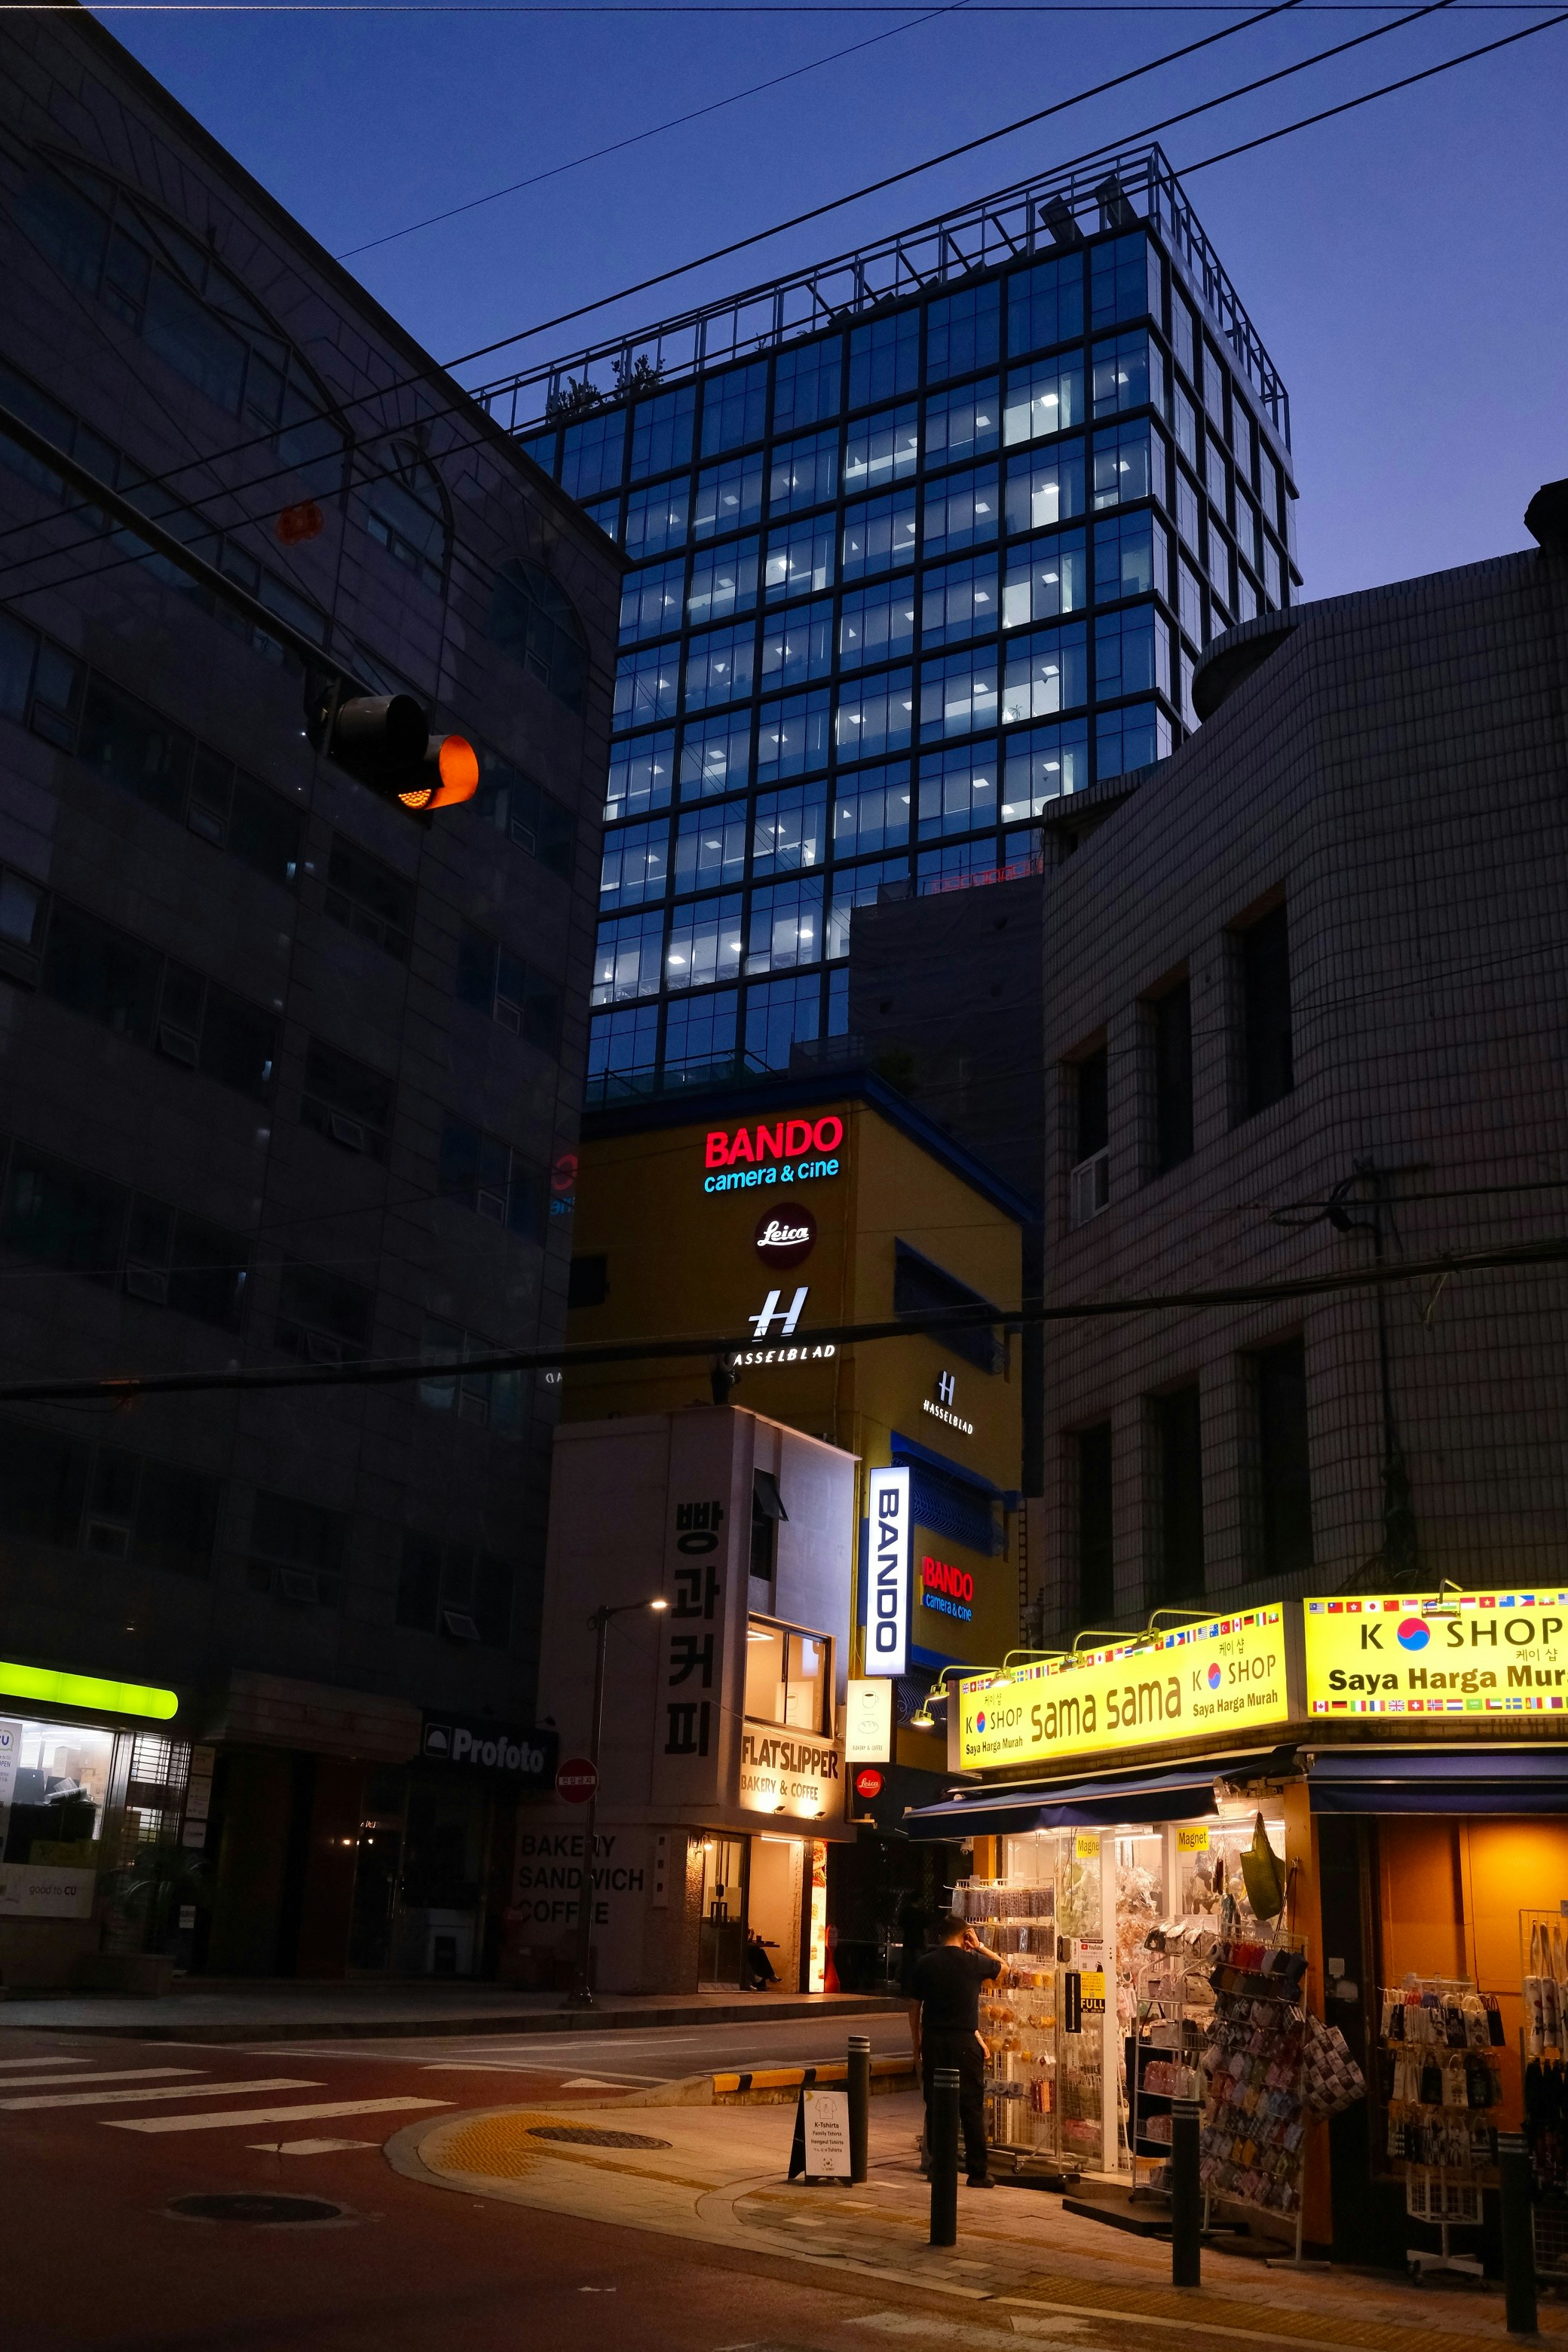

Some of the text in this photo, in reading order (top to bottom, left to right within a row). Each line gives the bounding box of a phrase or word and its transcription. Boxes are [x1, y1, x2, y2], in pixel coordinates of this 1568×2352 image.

[705, 1116, 844, 1168] BANDO
[704, 1159, 839, 1193] camera & cine
[757, 1220, 810, 1247] Leica
[733, 1345, 835, 1367] ASSELBLAD
[923, 1399, 973, 1435] HASSELBLAD
[876, 1488, 899, 1652] BANDO
[924, 1556, 974, 1602] BANDO
[926, 1593, 972, 1622] camera & cine
[665, 1501, 724, 1756] 빵과커피
[1361, 1617, 1563, 1649] K SHOP
[1220, 1637, 1245, 1657] 케이 샵
[1515, 1648, 1558, 1661] 케이 샵
[1193, 1654, 1276, 1692] K SHOP
[1328, 1664, 1568, 1695] Saya Harga Mur
[1031, 1676, 1182, 1743] sama sama
[1193, 1689, 1279, 1718] Saya Harga Murah
[966, 1707, 1023, 1734] K SHOP
[0, 1735, 10, 1747] U
[452, 1728, 544, 1774] Profoto
[966, 1735, 1024, 1756] Saya Harga Murah
[742, 1735, 839, 1780] FLATSLIPPER
[562, 1776, 592, 1785] 진입금지
[741, 1774, 819, 1801] BAKERY & COFFEE
[859, 1777, 881, 1789] Leica
[1077, 1839, 1100, 1854] Magne
[1178, 1831, 1207, 1847] Magnet
[29, 1885, 51, 1895] good
[64, 1886, 77, 1895] CU
[517, 1900, 609, 1924] COFFE
